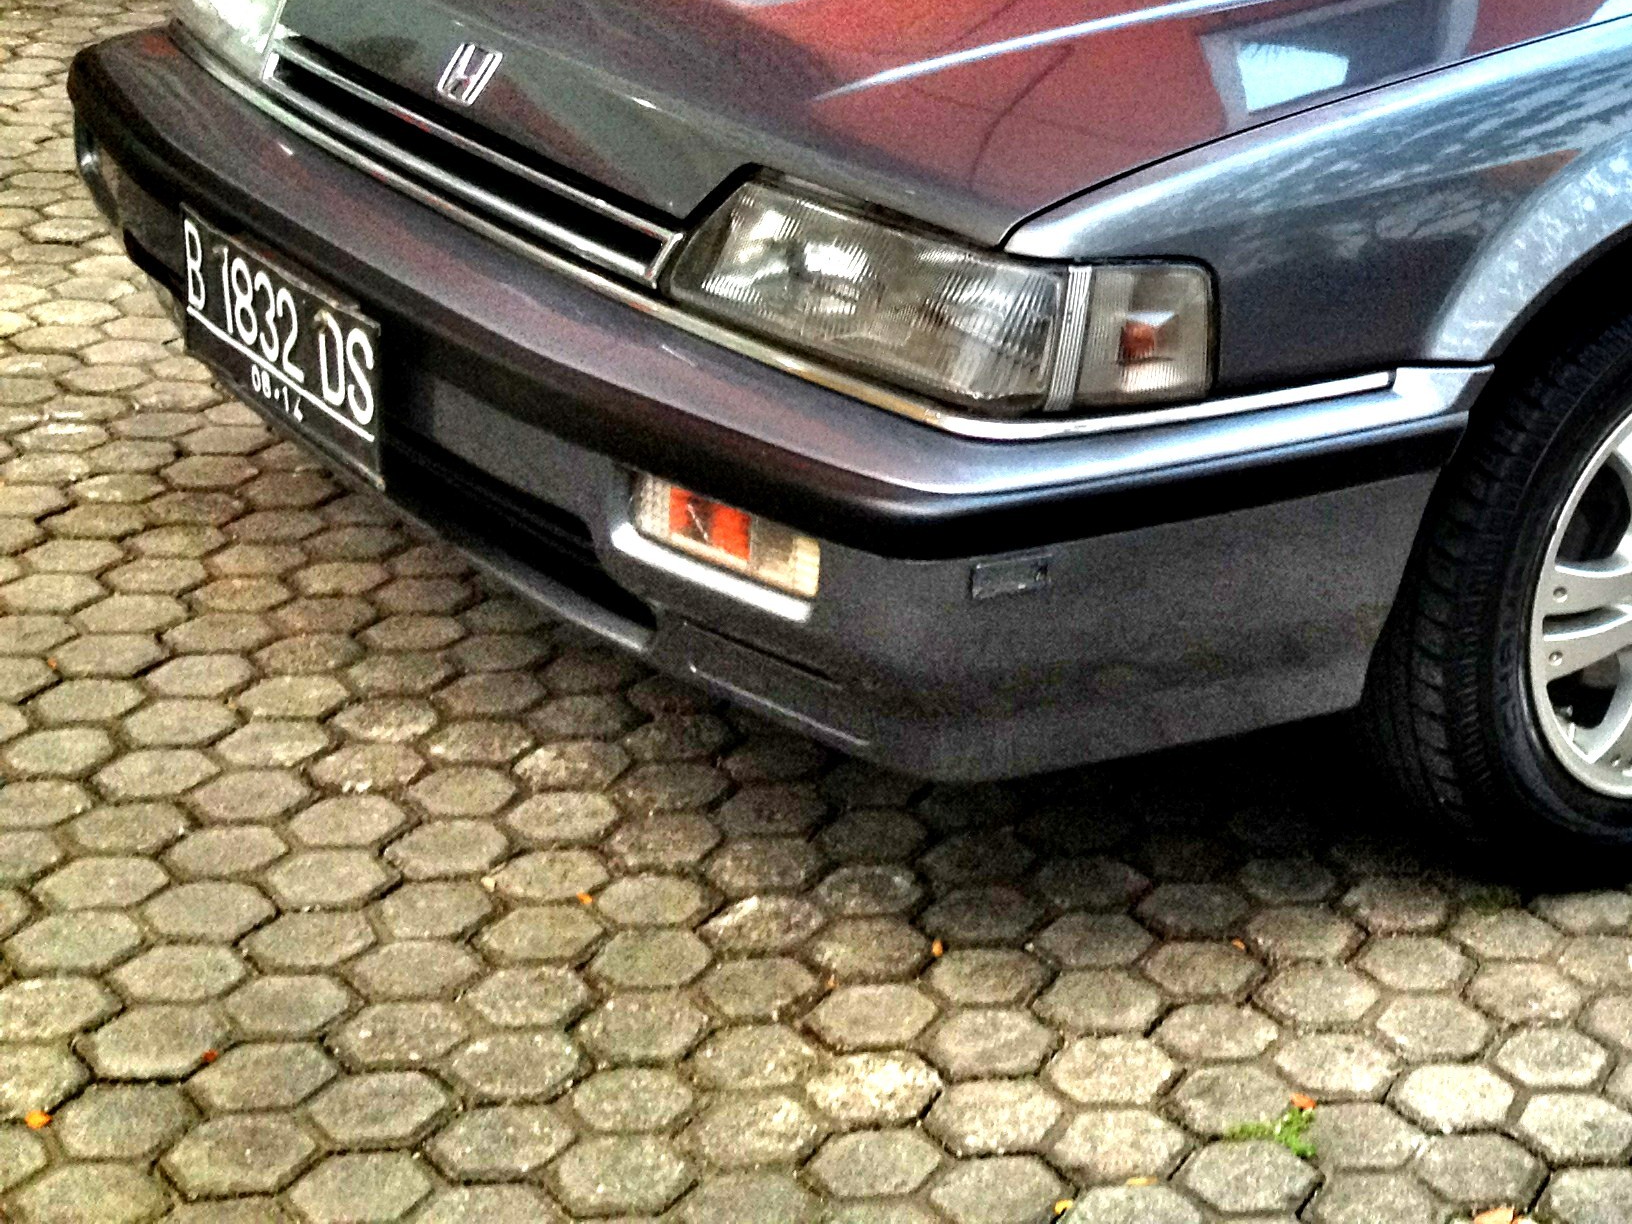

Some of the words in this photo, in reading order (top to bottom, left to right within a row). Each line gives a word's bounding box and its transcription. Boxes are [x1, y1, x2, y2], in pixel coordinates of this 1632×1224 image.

[184, 219, 206, 310] B
[222, 246, 304, 383] 1832
[317, 311, 374, 425] DS
